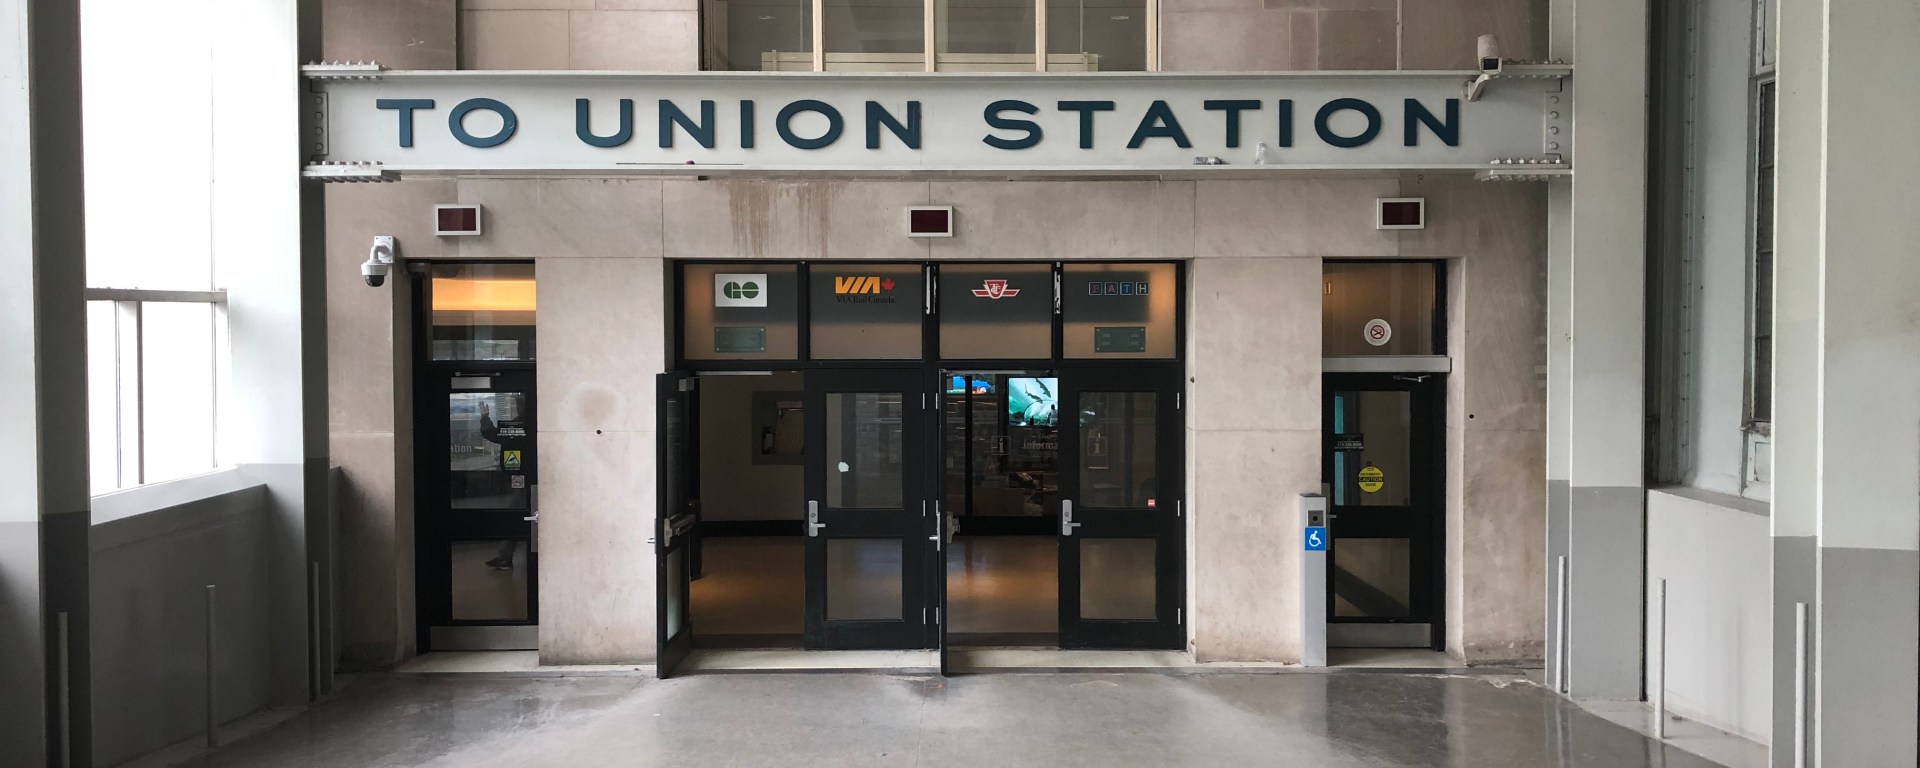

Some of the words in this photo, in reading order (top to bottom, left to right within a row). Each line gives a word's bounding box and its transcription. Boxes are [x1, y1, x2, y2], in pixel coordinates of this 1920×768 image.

[376, 97, 518, 148] TO
[575, 98, 922, 150] UNION
[982, 98, 1460, 150] STATION
[723, 281, 759, 299] GO
[835, 276, 880, 294] VIA
[1091, 283, 1147, 295] PATH
[836, 295, 852, 303] VIA
[853, 295, 867, 303] Rail
[868, 295, 895, 303] Canada
